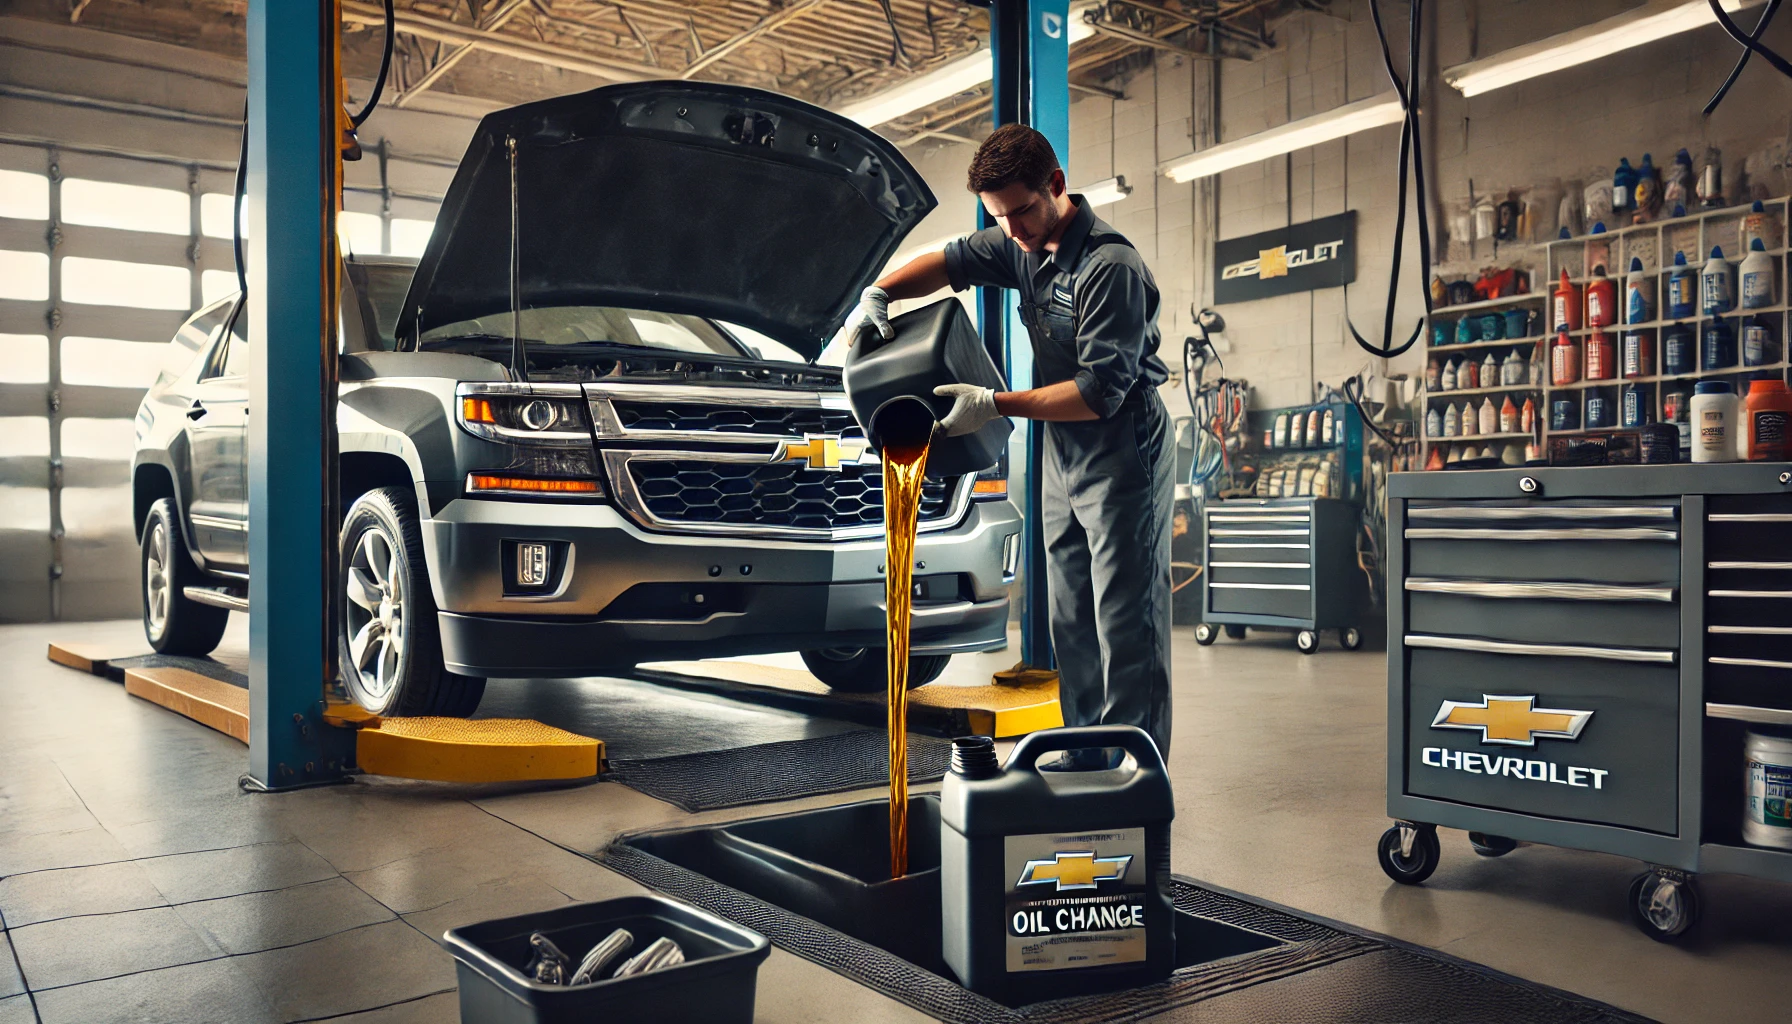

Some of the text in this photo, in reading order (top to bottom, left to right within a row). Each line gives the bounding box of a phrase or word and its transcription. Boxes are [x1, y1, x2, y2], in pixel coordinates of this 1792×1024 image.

[1422, 747, 1609, 789] CHEVROLET
[1012, 904, 1145, 934] OIL CHANGE
